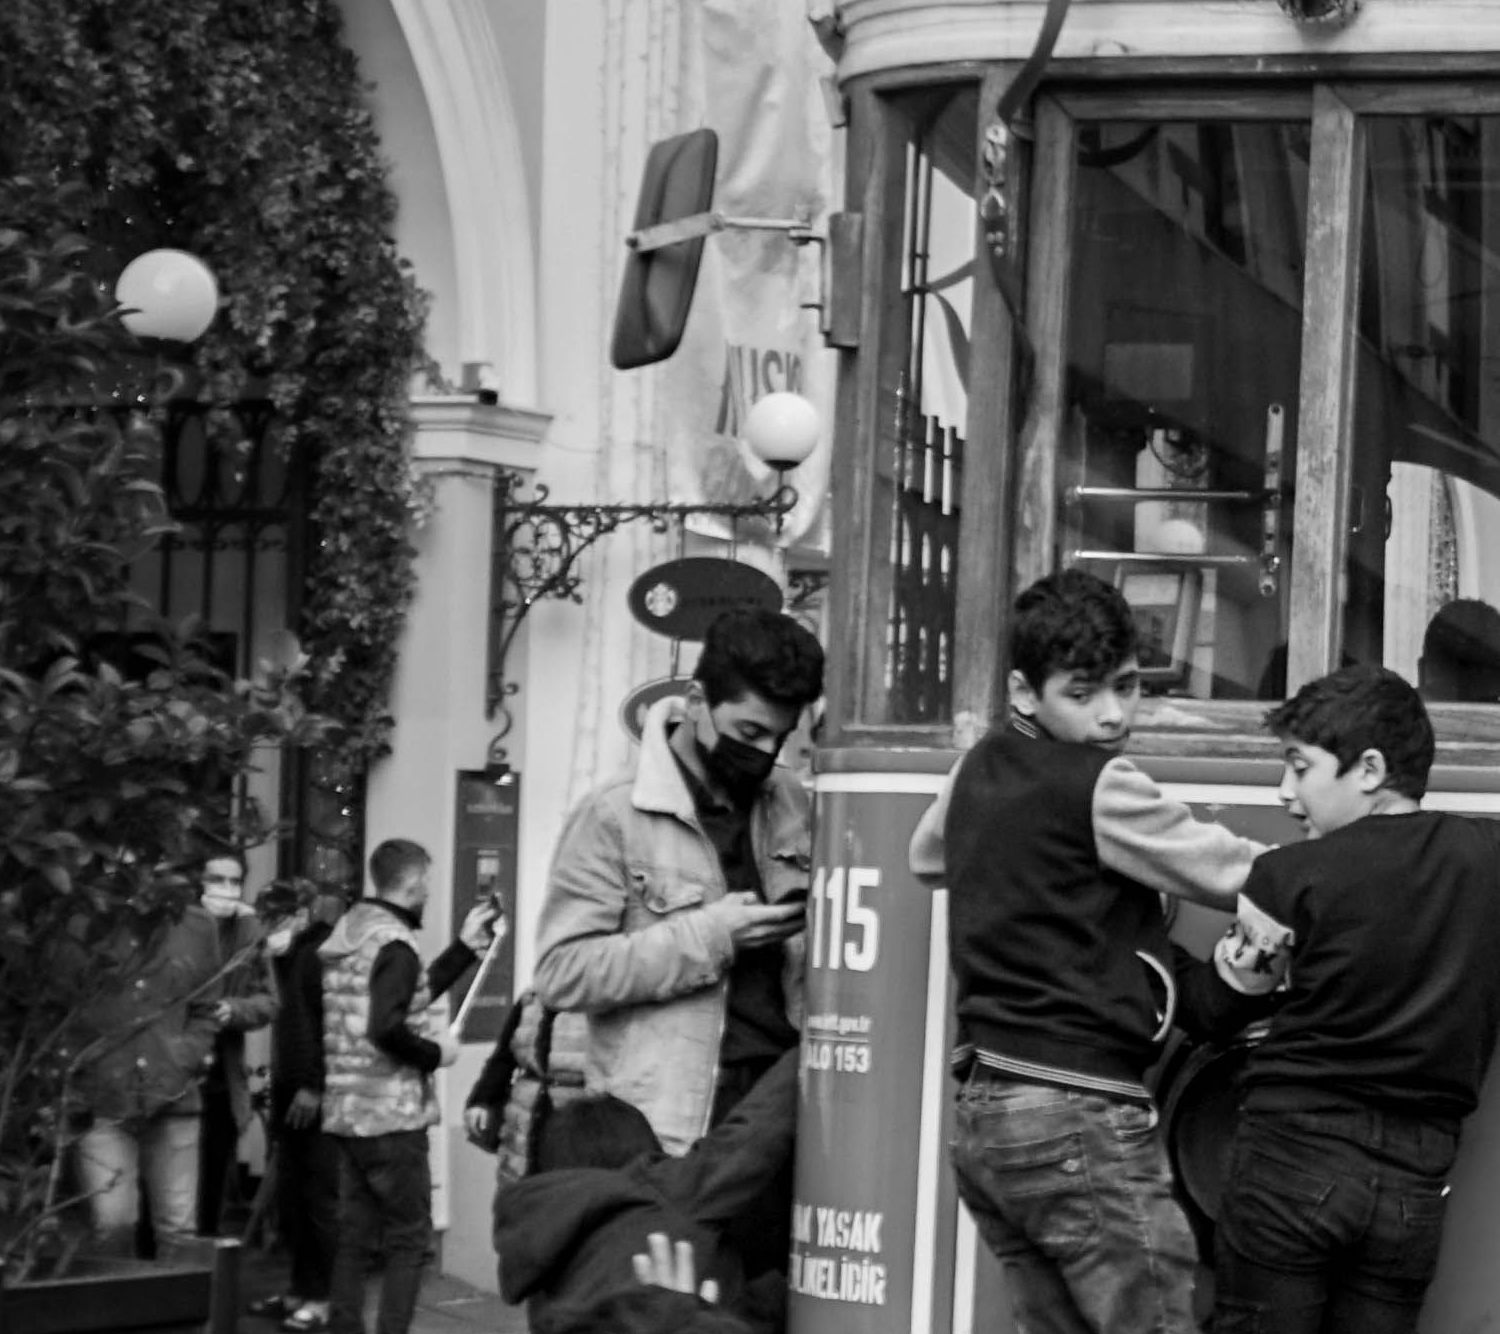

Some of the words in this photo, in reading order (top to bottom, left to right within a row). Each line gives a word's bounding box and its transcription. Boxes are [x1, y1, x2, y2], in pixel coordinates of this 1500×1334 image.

[811, 866, 882, 972] 115
[834, 1045, 871, 1074] 153
[816, 1206, 884, 1254] YASAK
